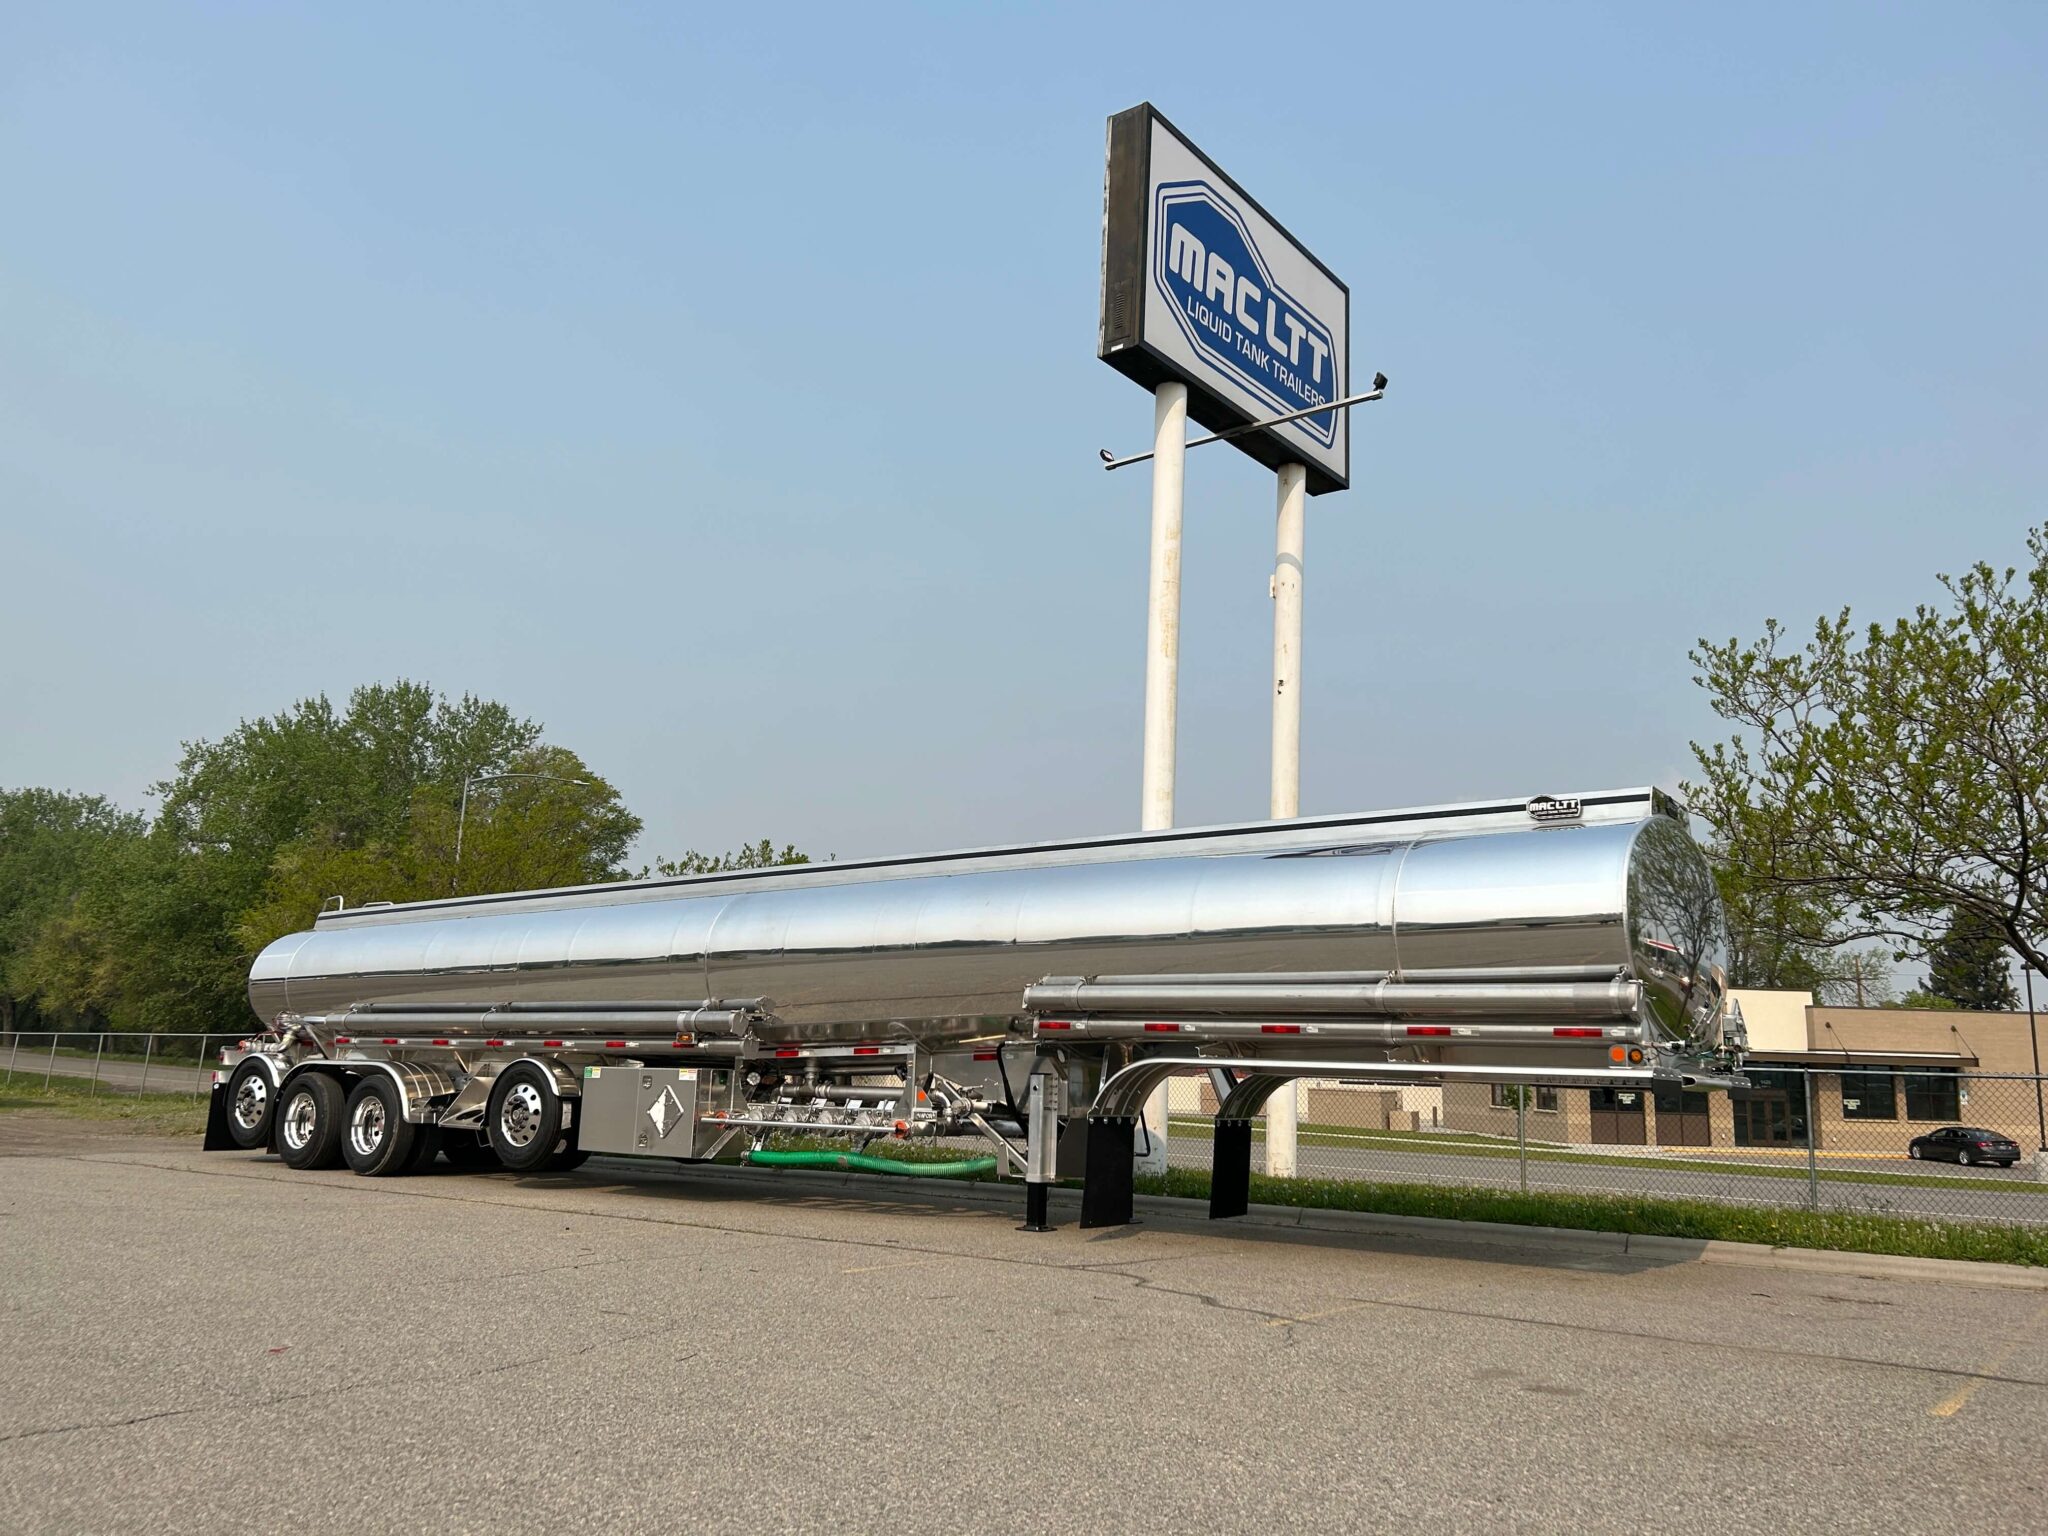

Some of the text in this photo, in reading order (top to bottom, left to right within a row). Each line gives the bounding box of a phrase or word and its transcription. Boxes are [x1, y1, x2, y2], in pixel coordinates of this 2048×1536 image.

[1187, 295, 1326, 407] LIQUID TANK TRAILERS
